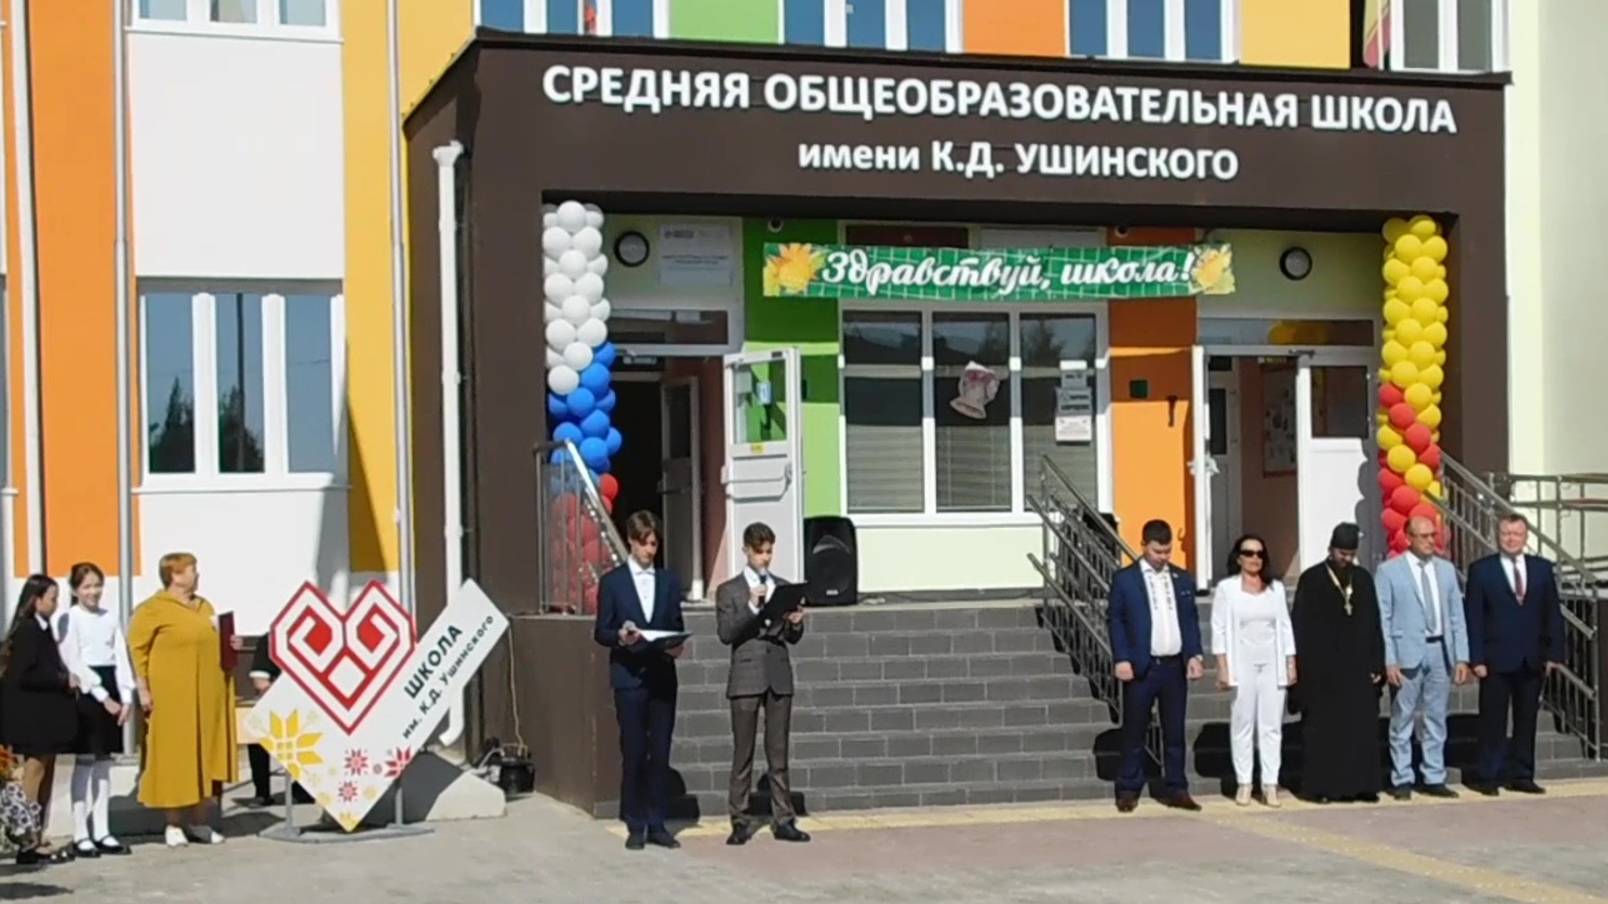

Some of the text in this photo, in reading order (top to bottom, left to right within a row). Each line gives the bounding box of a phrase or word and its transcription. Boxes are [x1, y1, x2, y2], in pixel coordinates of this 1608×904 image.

[542, 64, 1458, 134] СРЕДНЯЯ ОБЩЕОБРАЗОВАТЕЛЬНАЯ ШКОЛА
[797, 141, 1240, 180] имени К.Д. УШИНСКОГО
[821, 248, 1194, 296] Здравствуй, школа!
[402, 717, 423, 739] им.
[439, 615, 495, 686] Ушинского
[403, 624, 463, 699] ШКОЛА
